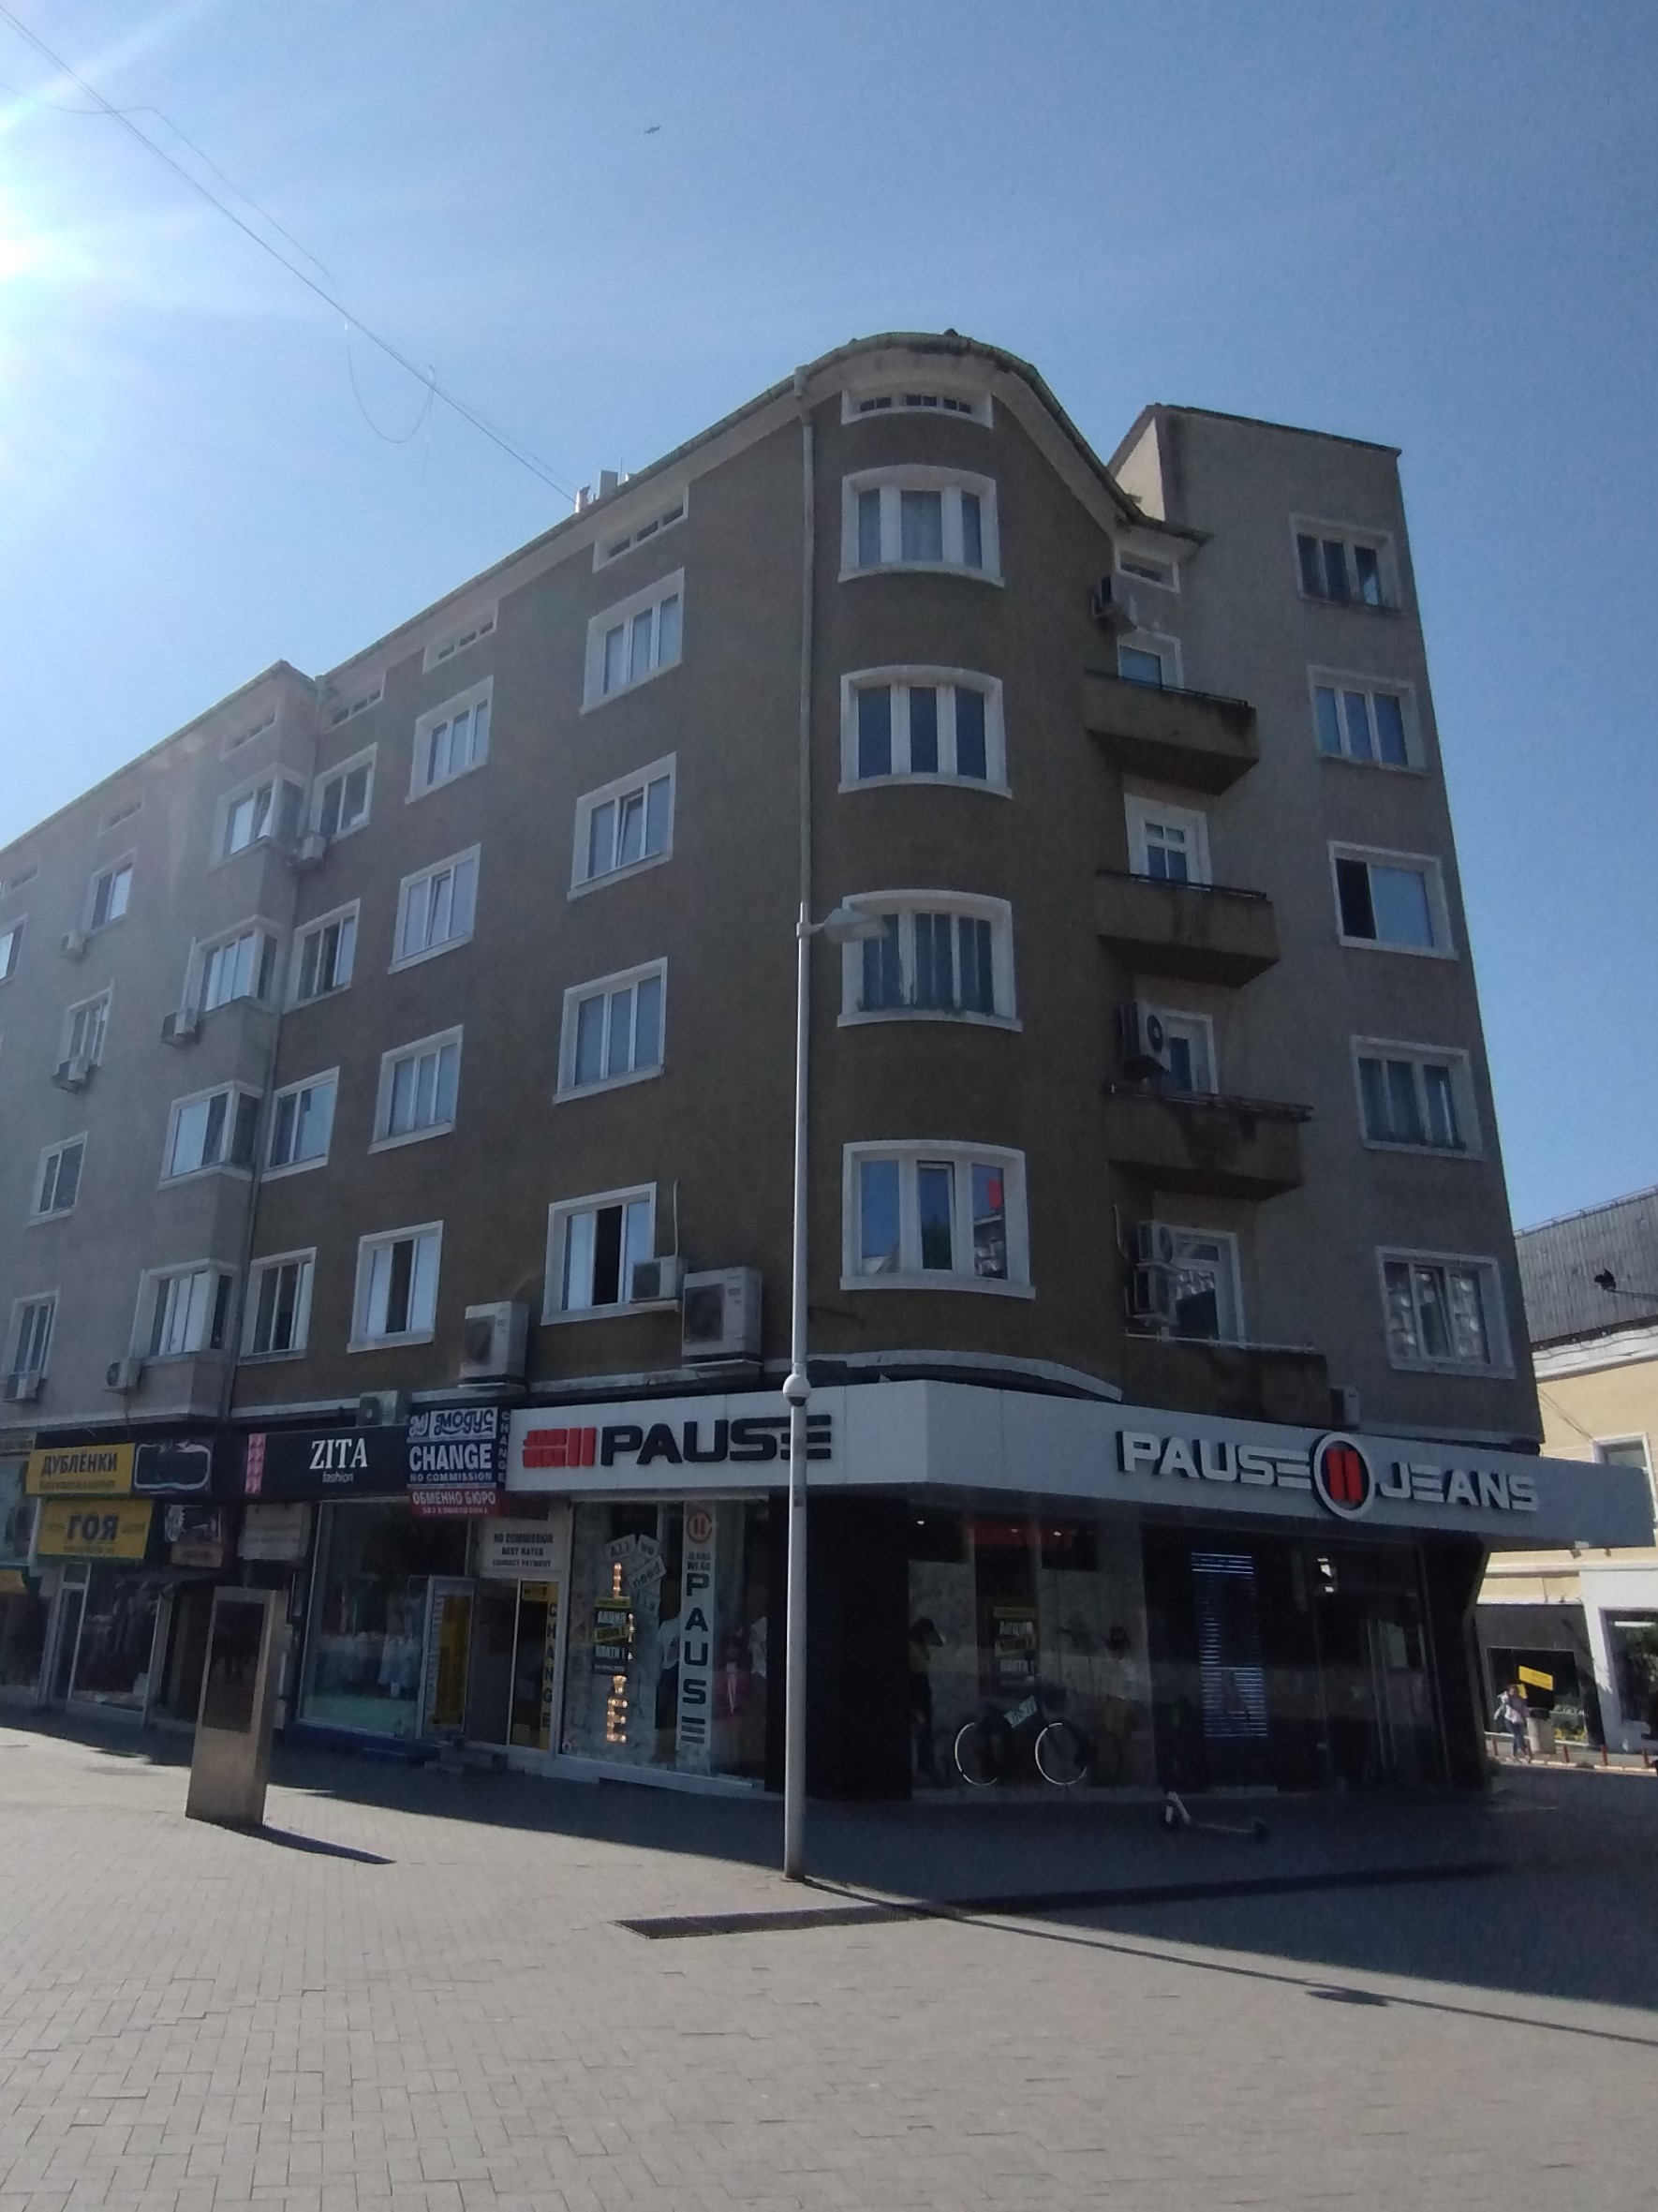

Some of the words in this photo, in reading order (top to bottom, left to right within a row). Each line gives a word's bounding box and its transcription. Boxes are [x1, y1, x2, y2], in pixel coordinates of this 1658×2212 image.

[309, 1437, 369, 1470] ZITA
[600, 1415, 831, 1465] PAUSE
[41, 1450, 118, 1477] ДУБЛЁНКИ
[408, 1444, 493, 1472] CHANGE
[1117, 1431, 1311, 1490] PAUSE
[1375, 1461, 1539, 1512] JEANS
[322, 1471, 354, 1483] fashion
[409, 1474, 424, 1482] NO
[426, 1472, 493, 1482] COMMISSION
[465, 1492, 496, 1505] БЮРО
[67, 1512, 119, 1541] ГОЯ
[501, 1548, 519, 1556] BEST
[681, 1573, 711, 1744] PAUSE
